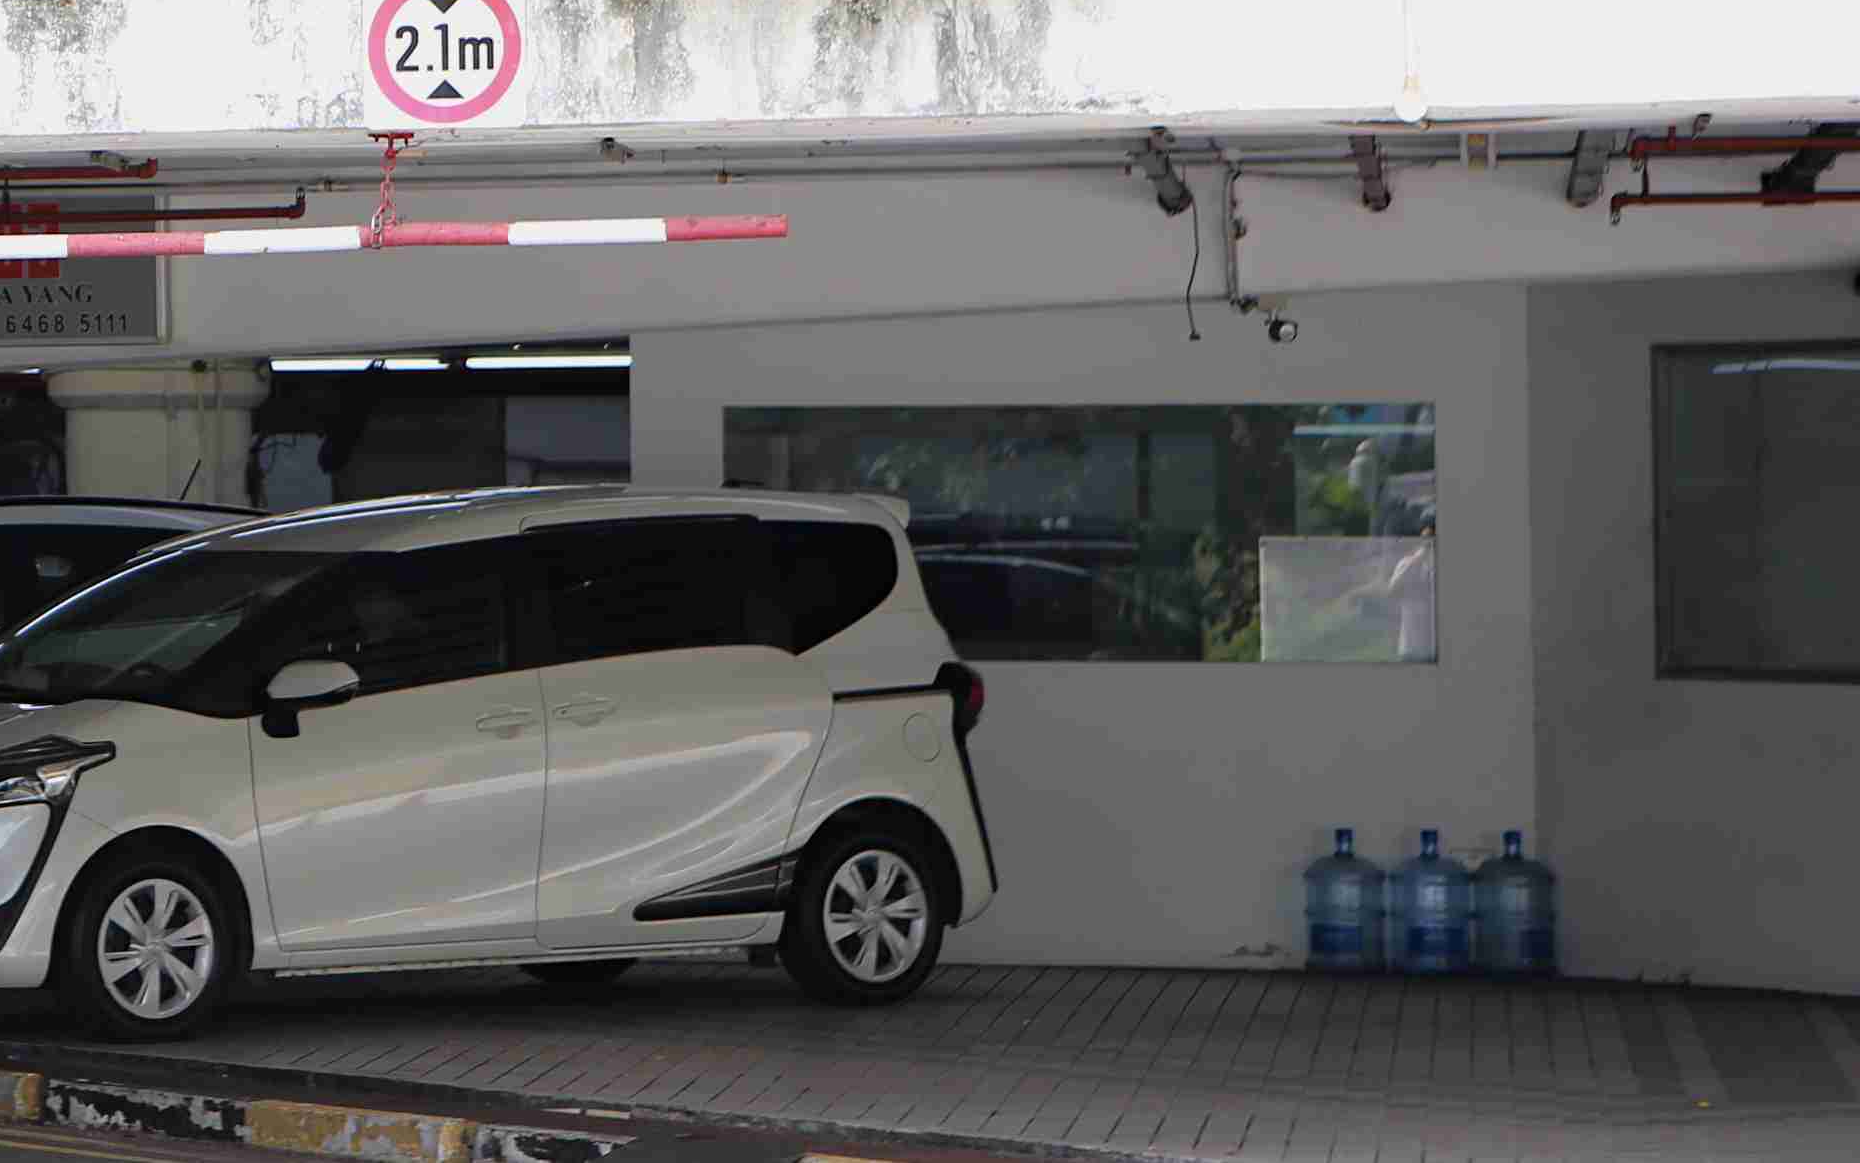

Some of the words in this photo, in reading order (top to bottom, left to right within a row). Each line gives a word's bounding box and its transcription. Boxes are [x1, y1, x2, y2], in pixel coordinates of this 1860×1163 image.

[395, 23, 494, 72] 2.1m
[22, 284, 92, 305] YANG
[5, 313, 66, 335] 6468
[79, 312, 128, 334] 5111
